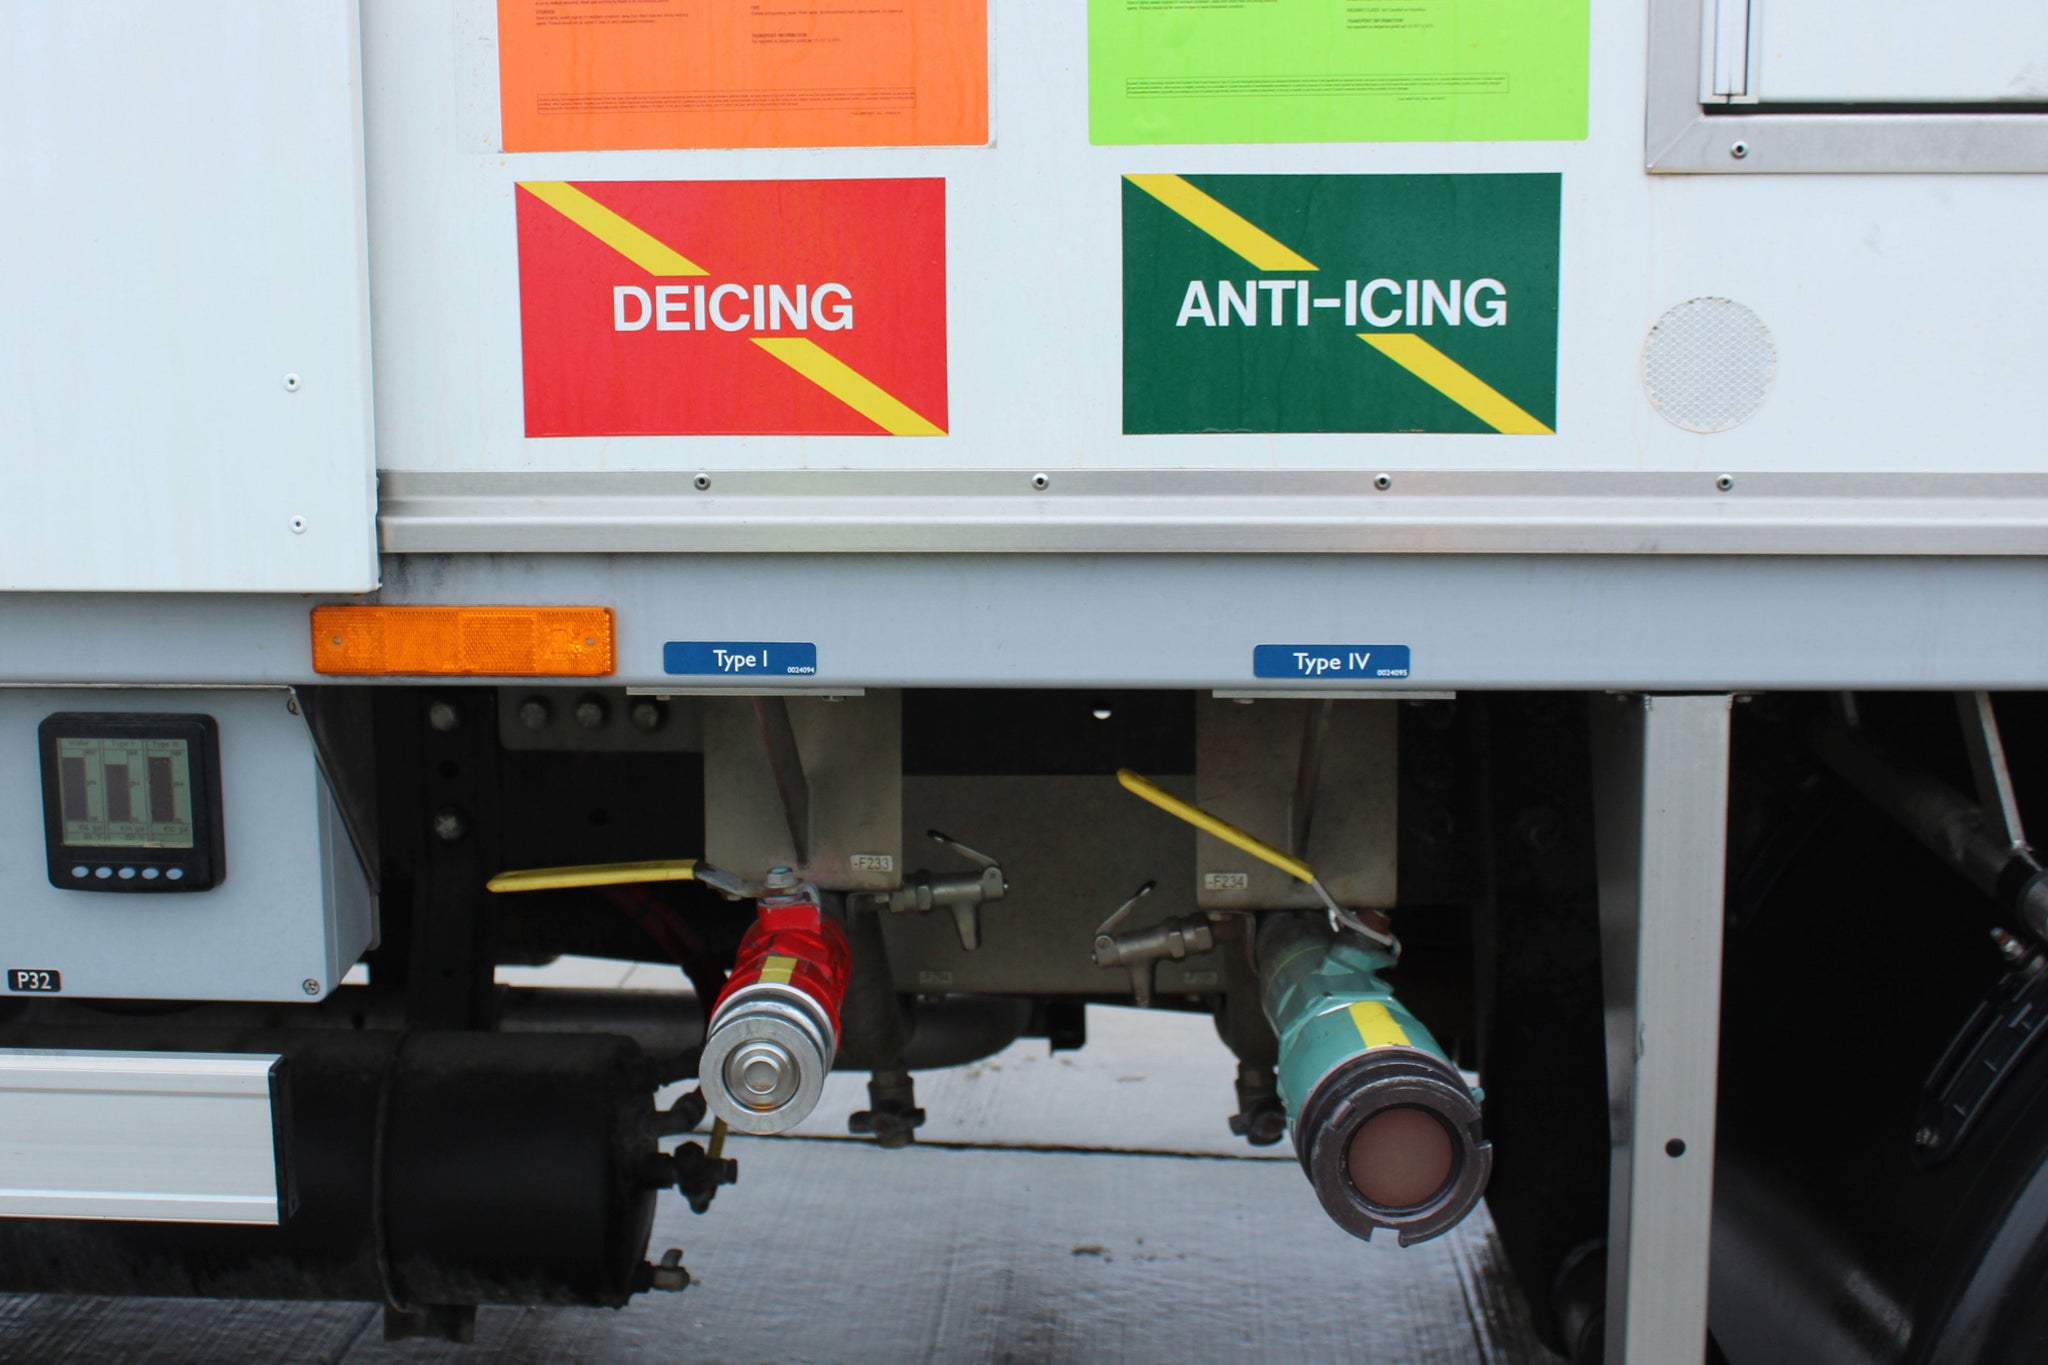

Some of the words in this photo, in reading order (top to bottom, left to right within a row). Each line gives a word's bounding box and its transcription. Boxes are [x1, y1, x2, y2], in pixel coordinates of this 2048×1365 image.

[612, 282, 854, 332] DEICING
[1175, 277, 1507, 328] ANTI-ICING
[712, 649, 757, 673] Type
[762, 650, 768, 667] I
[1293, 652, 1342, 675] Type
[1349, 652, 1371, 670] IV
[17, 971, 52, 990] P32
